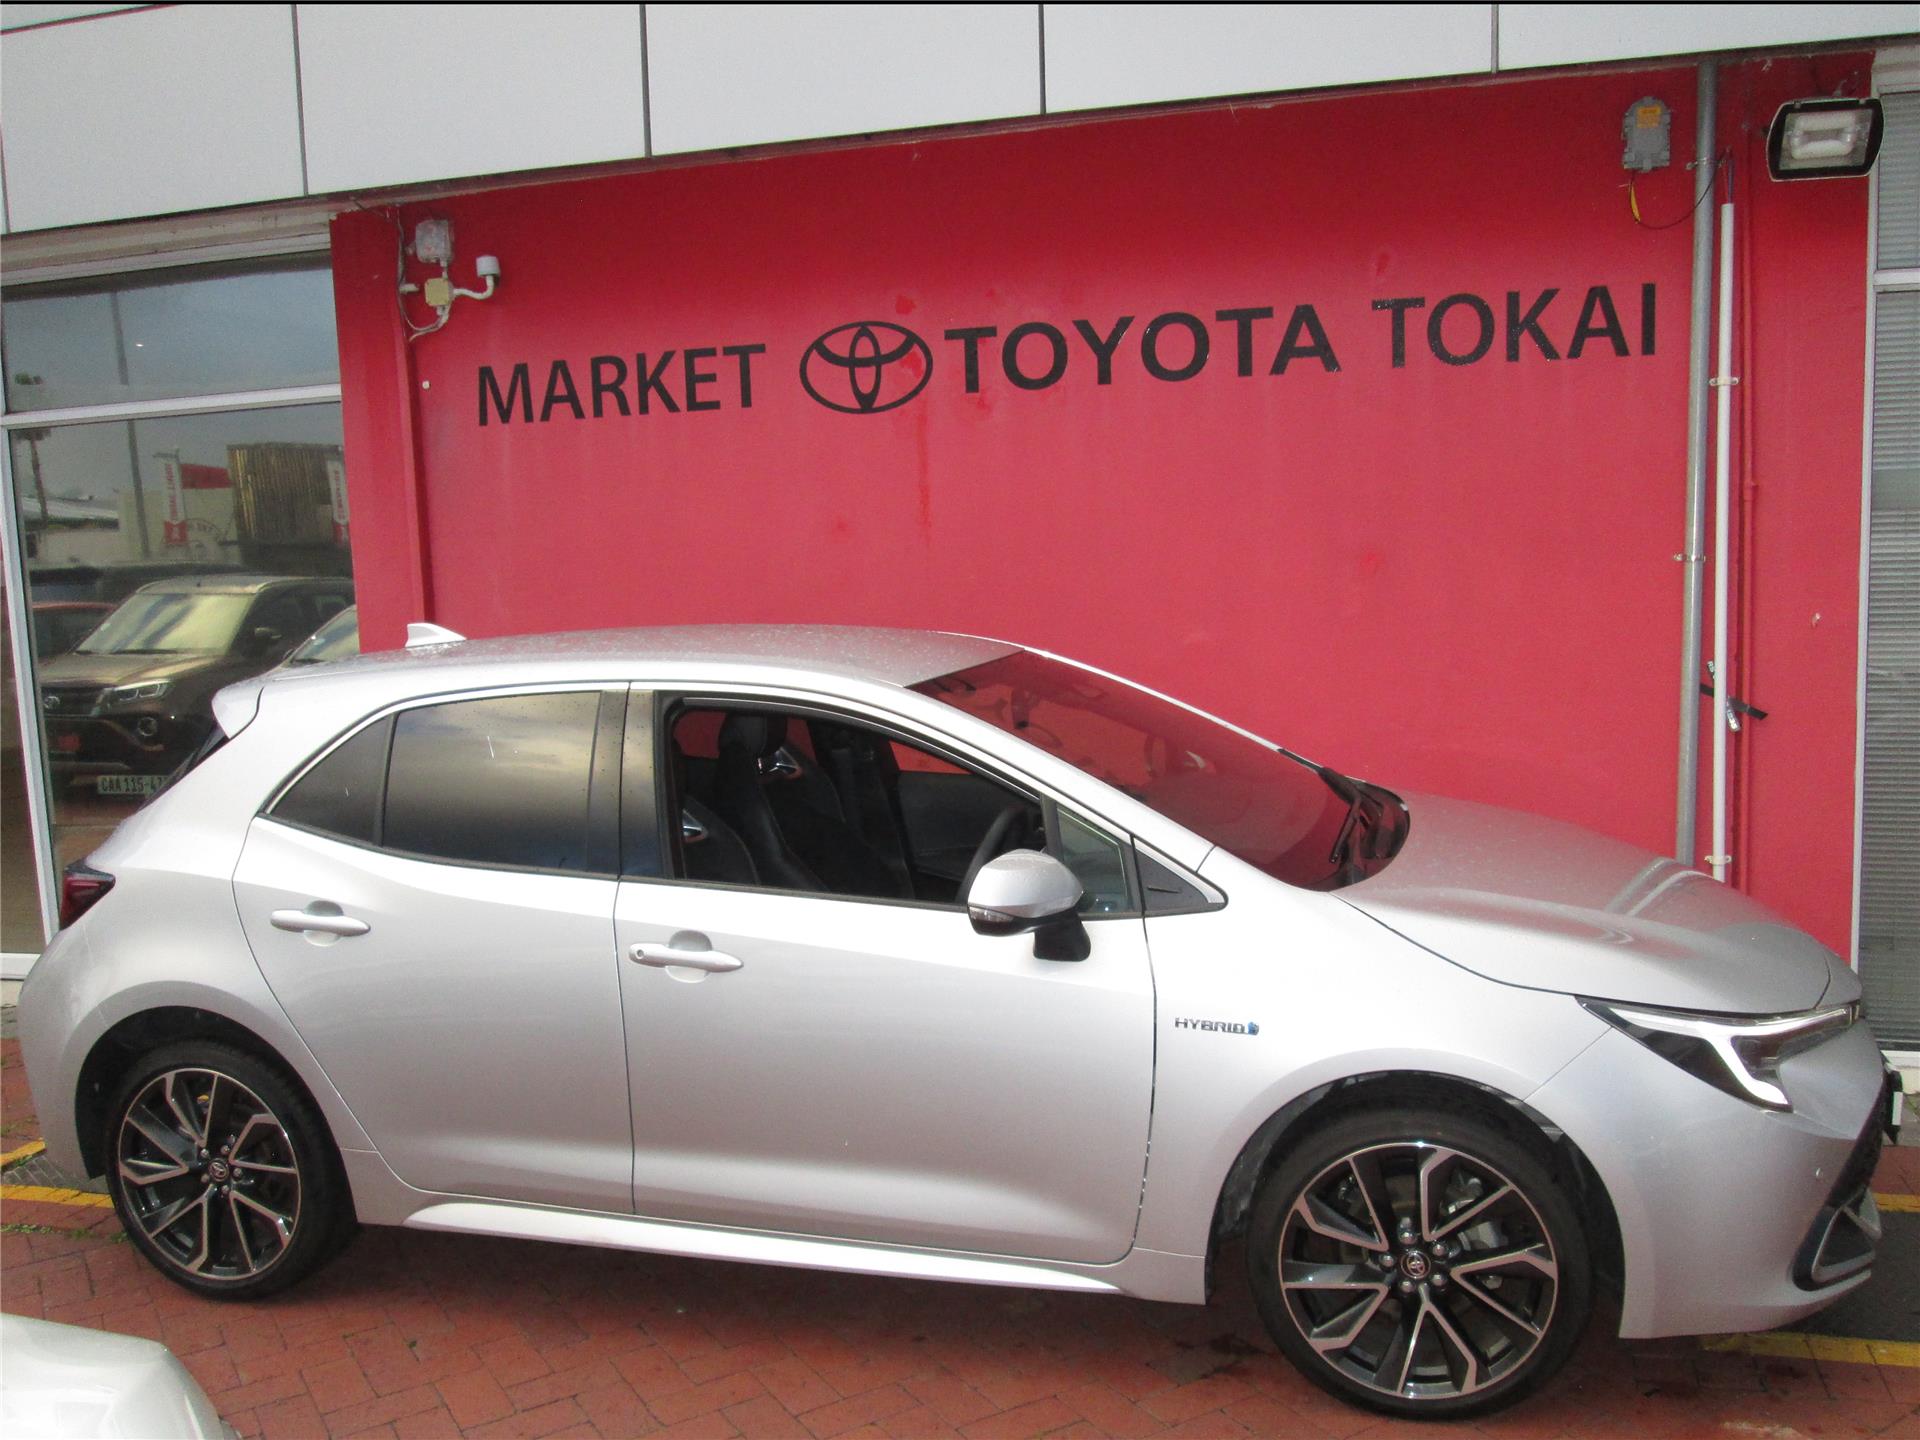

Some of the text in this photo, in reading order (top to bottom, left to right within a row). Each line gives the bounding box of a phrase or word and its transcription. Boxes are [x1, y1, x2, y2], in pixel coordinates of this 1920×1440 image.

[479, 283, 1657, 426] MARKET TOYOTA TOKAI
[1175, 1017, 1245, 1034] HYBRID
